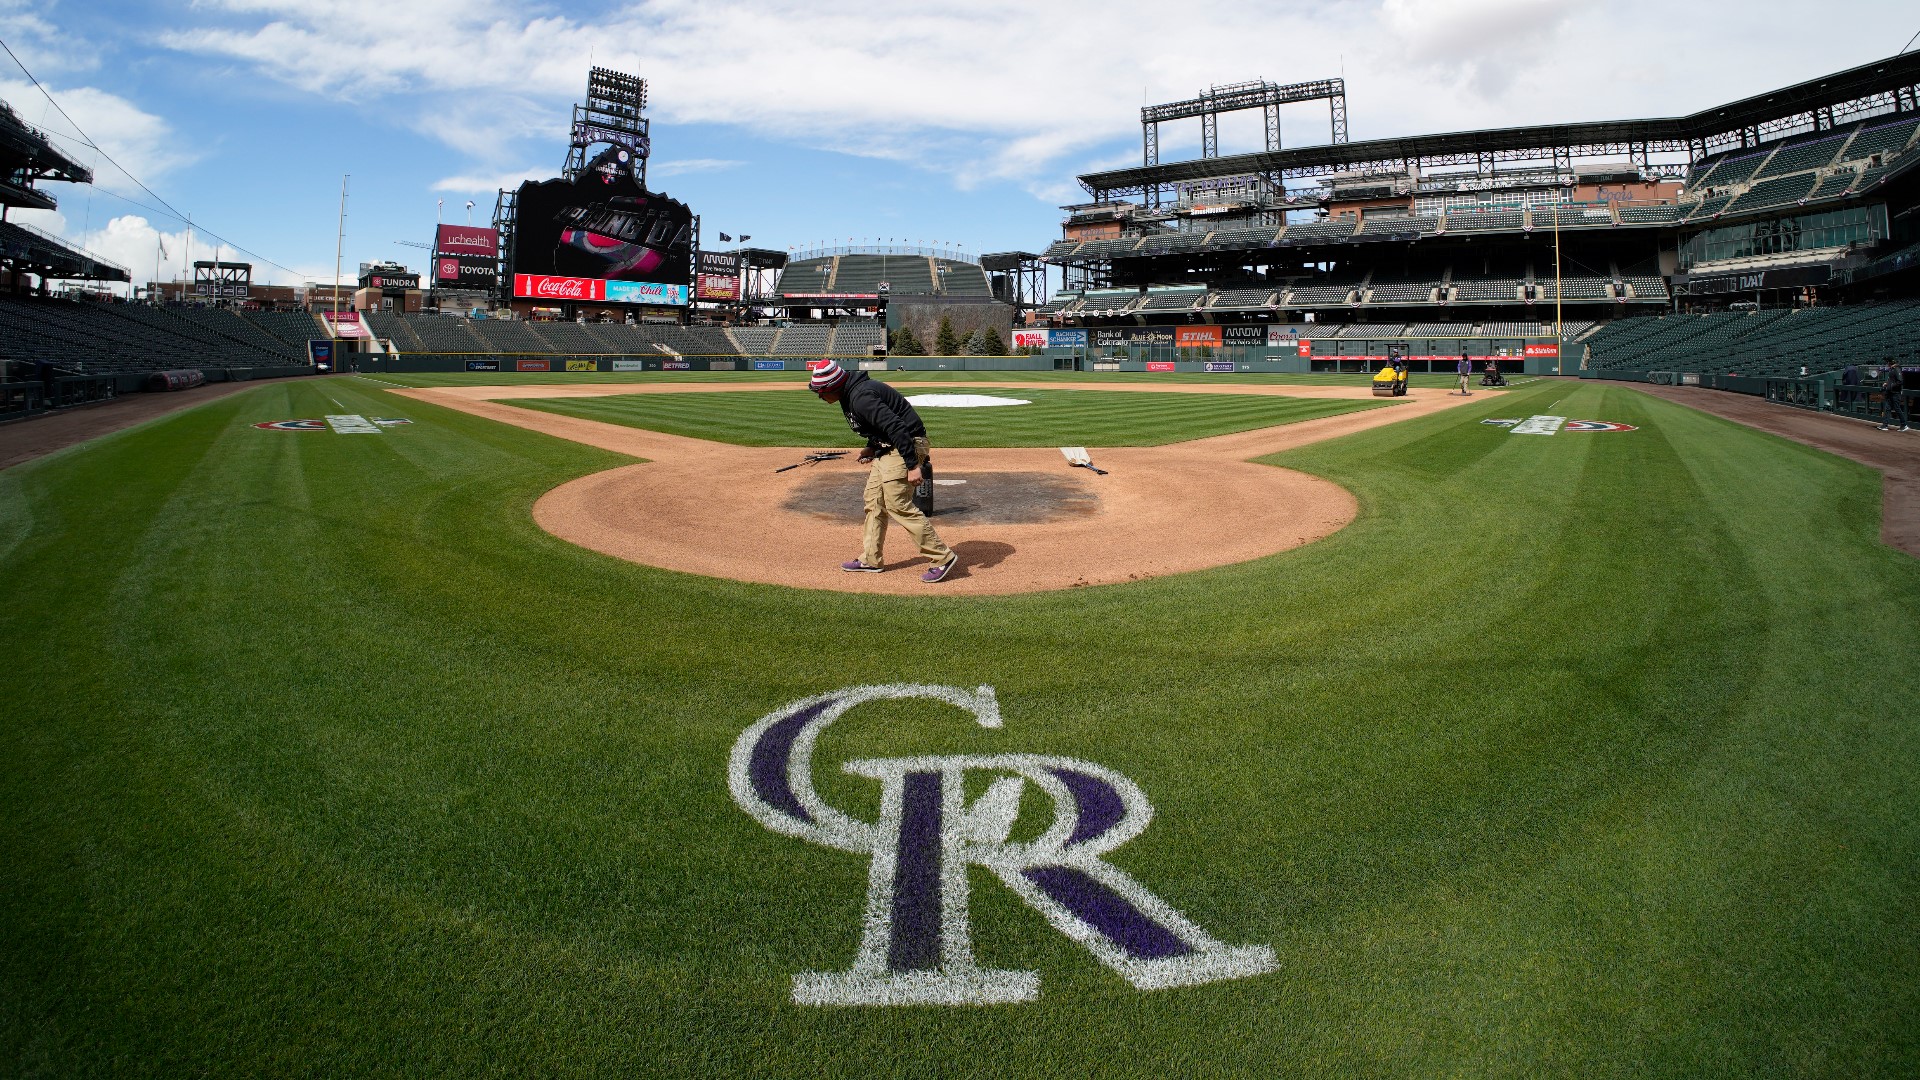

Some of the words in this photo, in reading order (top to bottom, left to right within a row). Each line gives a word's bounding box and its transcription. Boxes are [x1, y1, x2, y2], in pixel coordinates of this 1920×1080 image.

[448, 233, 490, 247] uchealth
[703, 254, 736, 266] ARROW
[460, 265, 495, 275] TOYOTA
[382, 278, 416, 287] TUNDRA
[706, 277, 733, 288] KING
[1740, 272, 1766, 289] DAY
[538, 277, 583, 297] Coca-Cola
[640, 284, 663, 295] Chill
[1097, 330, 1114, 338] Bank
[1114, 330, 1122, 338] of
[1182, 332, 1215, 340] STIHL
[1226, 327, 1261, 337] ARROW
[1097, 338, 1128, 346] Colorado
[663, 361, 690, 369] BETFRED
